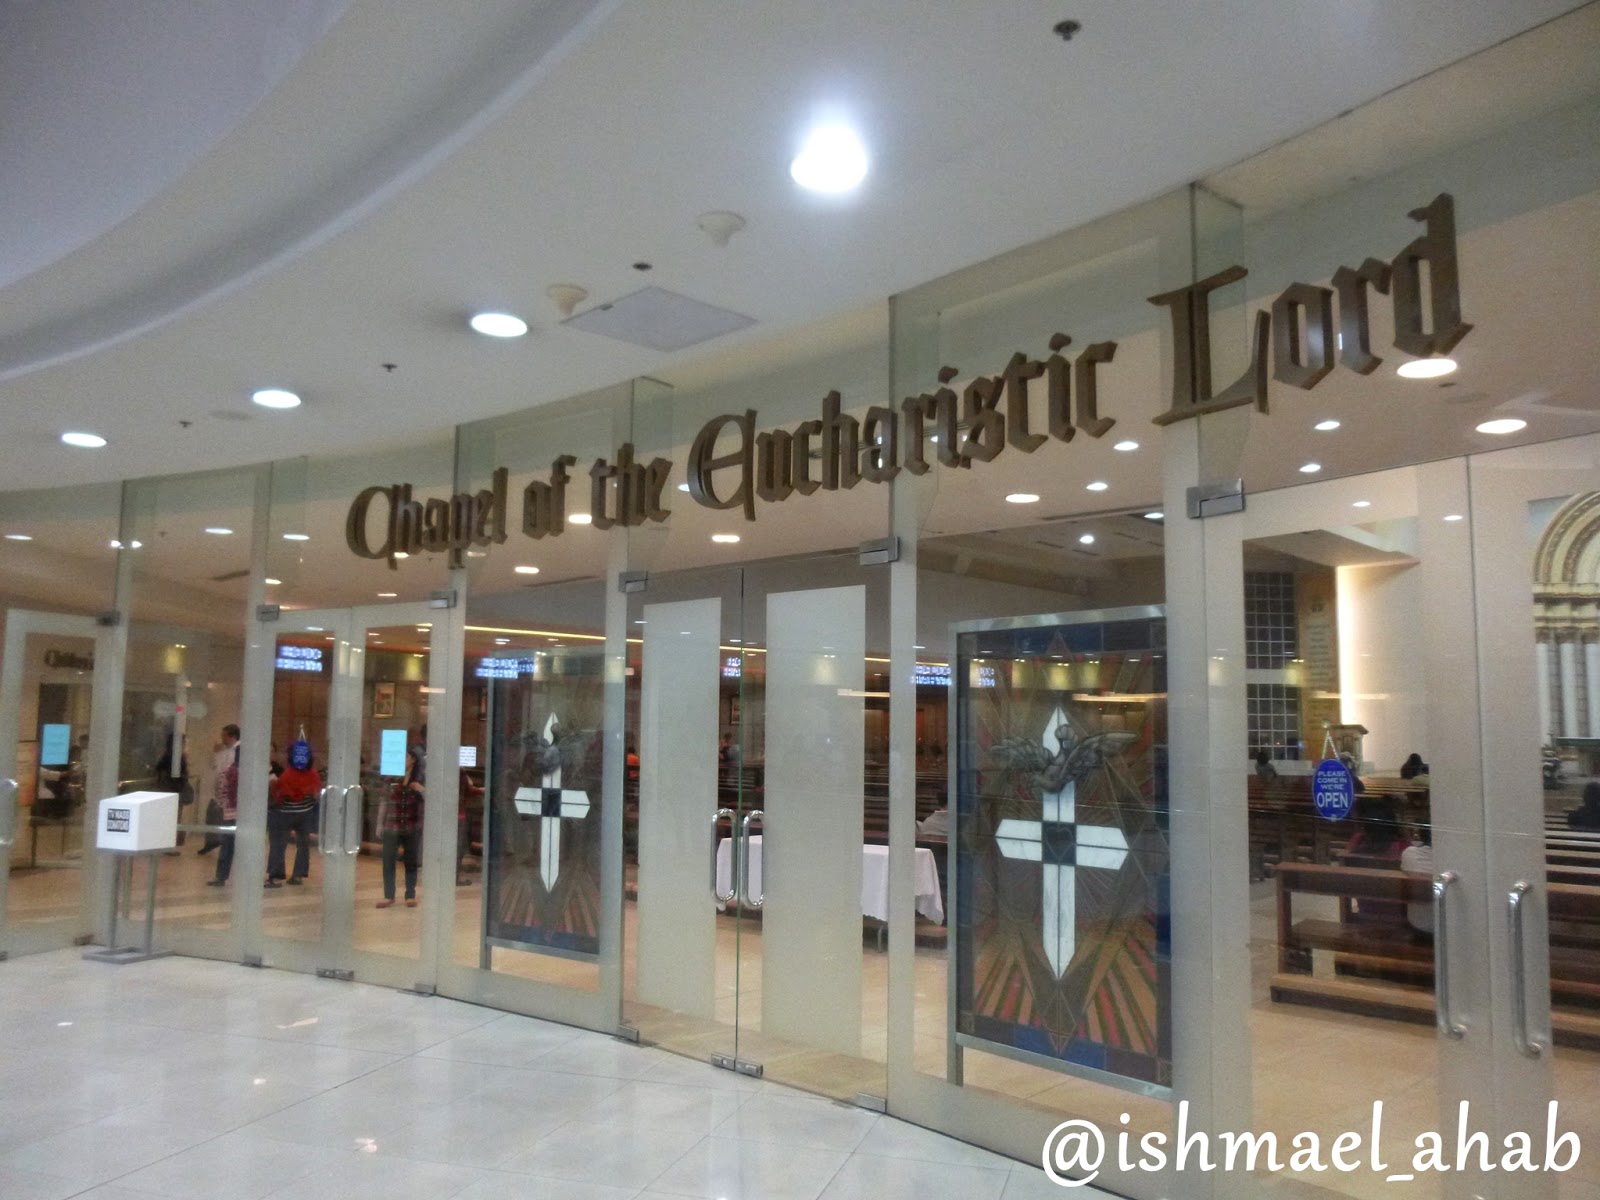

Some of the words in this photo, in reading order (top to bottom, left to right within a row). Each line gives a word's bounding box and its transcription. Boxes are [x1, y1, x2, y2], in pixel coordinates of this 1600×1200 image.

[346, 467, 508, 570] Chapel
[522, 454, 577, 540] of
[588, 443, 672, 530] the
[687, 332, 1118, 521] Eucharistic
[1146, 192, 1475, 427] Lord
[1317, 792, 1348, 808] OPEN
